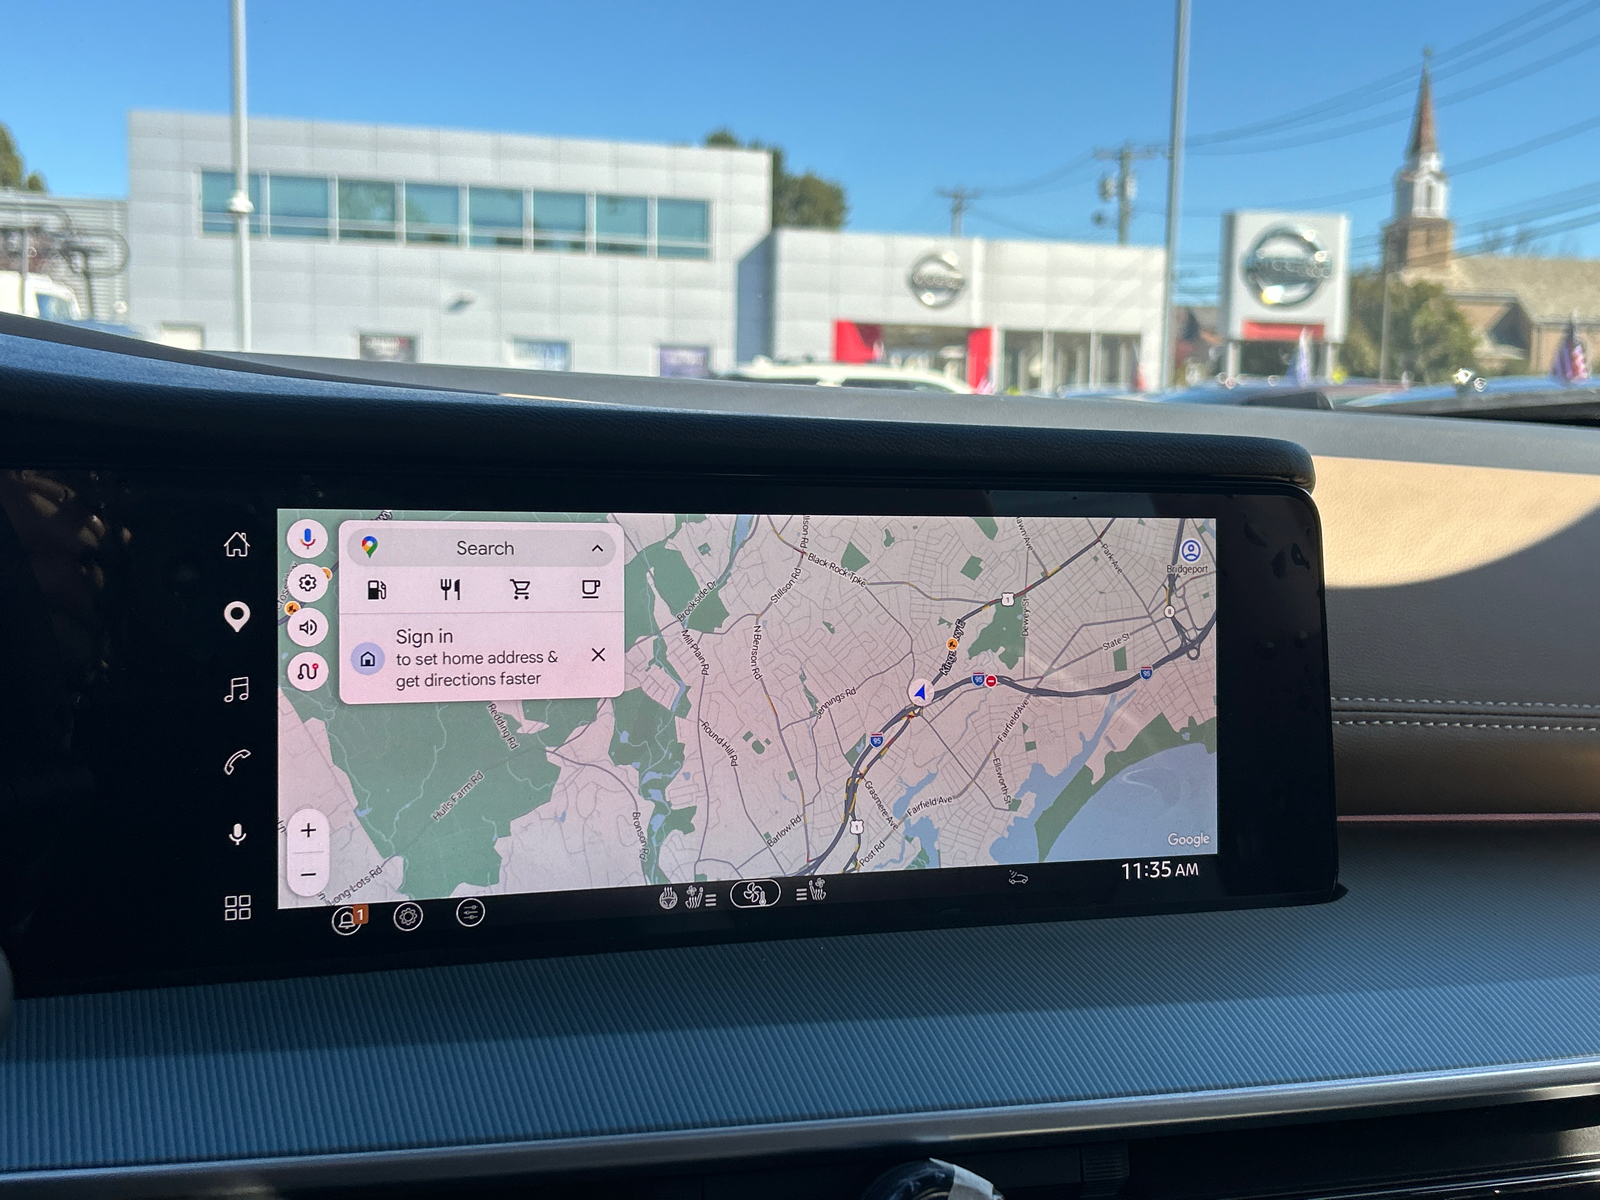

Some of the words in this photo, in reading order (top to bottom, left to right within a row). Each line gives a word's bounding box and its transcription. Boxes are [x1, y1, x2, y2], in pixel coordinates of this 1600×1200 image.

[456, 540, 515, 556] Search
[800, 537, 809, 549] Rd
[1023, 537, 1034, 551] Ave
[807, 552, 829, 568] Black
[828, 562, 849, 577] Rock
[848, 572, 867, 588] Tpke
[1101, 543, 1113, 561] Park
[1110, 559, 1123, 575] Ave
[1166, 564, 1209, 574] Bridgeport
[770, 579, 797, 604] Stillson
[790, 567, 802, 580] Rd
[676, 587, 709, 622] Brookside
[706, 580, 718, 591] Dr
[753, 625, 762, 633] N
[1021, 608, 1031, 637] Dewey
[396, 628, 434, 648] Sign
[439, 628, 454, 644] in
[750, 634, 762, 667] Benson
[1102, 636, 1122, 651] State
[1121, 633, 1131, 642] St
[396, 653, 411, 666] to
[415, 653, 438, 666] set
[442, 652, 484, 665] home
[487, 650, 544, 664] address
[547, 650, 558, 663] &
[681, 629, 694, 646] Mill
[689, 643, 706, 664] Plain
[701, 663, 710, 676] Rd
[396, 675, 420, 691] get
[424, 672, 497, 687] directions
[500, 671, 541, 686] faster
[752, 667, 764, 681] Rd
[815, 693, 846, 719] Jennings
[844, 686, 857, 698] Rd
[488, 703, 511, 739] Redding
[507, 736, 519, 750] Rd
[997, 709, 1020, 743] Fairfield
[1017, 699, 1029, 714] Ave
[701, 721, 724, 745] Round
[721, 740, 735, 757] Hill
[729, 755, 739, 767] Rd
[993, 757, 1010, 797] Ellsworth
[1003, 796, 1013, 805] St
[432, 801, 454, 821] Hulls
[450, 782, 474, 803] Farm
[470, 771, 484, 785] Rd
[864, 780, 889, 818] Grasmere
[885, 815, 899, 831] Ave
[906, 798, 937, 817] Fairfield
[937, 796, 953, 805] Ave
[632, 811, 649, 847] Bronson
[766, 824, 792, 848] Barlow
[789, 814, 802, 827] Rd
[1167, 832, 1210, 848] Google
[638, 848, 650, 861] Rd
[859, 850, 875, 866] Post
[873, 840, 886, 853] Rd
[349, 875, 371, 892] Lots
[368, 864, 384, 879] Rd
[1121, 860, 1172, 880] 11:35
[1175, 862, 1199, 877] AM
[356, 908, 364, 921] 1
